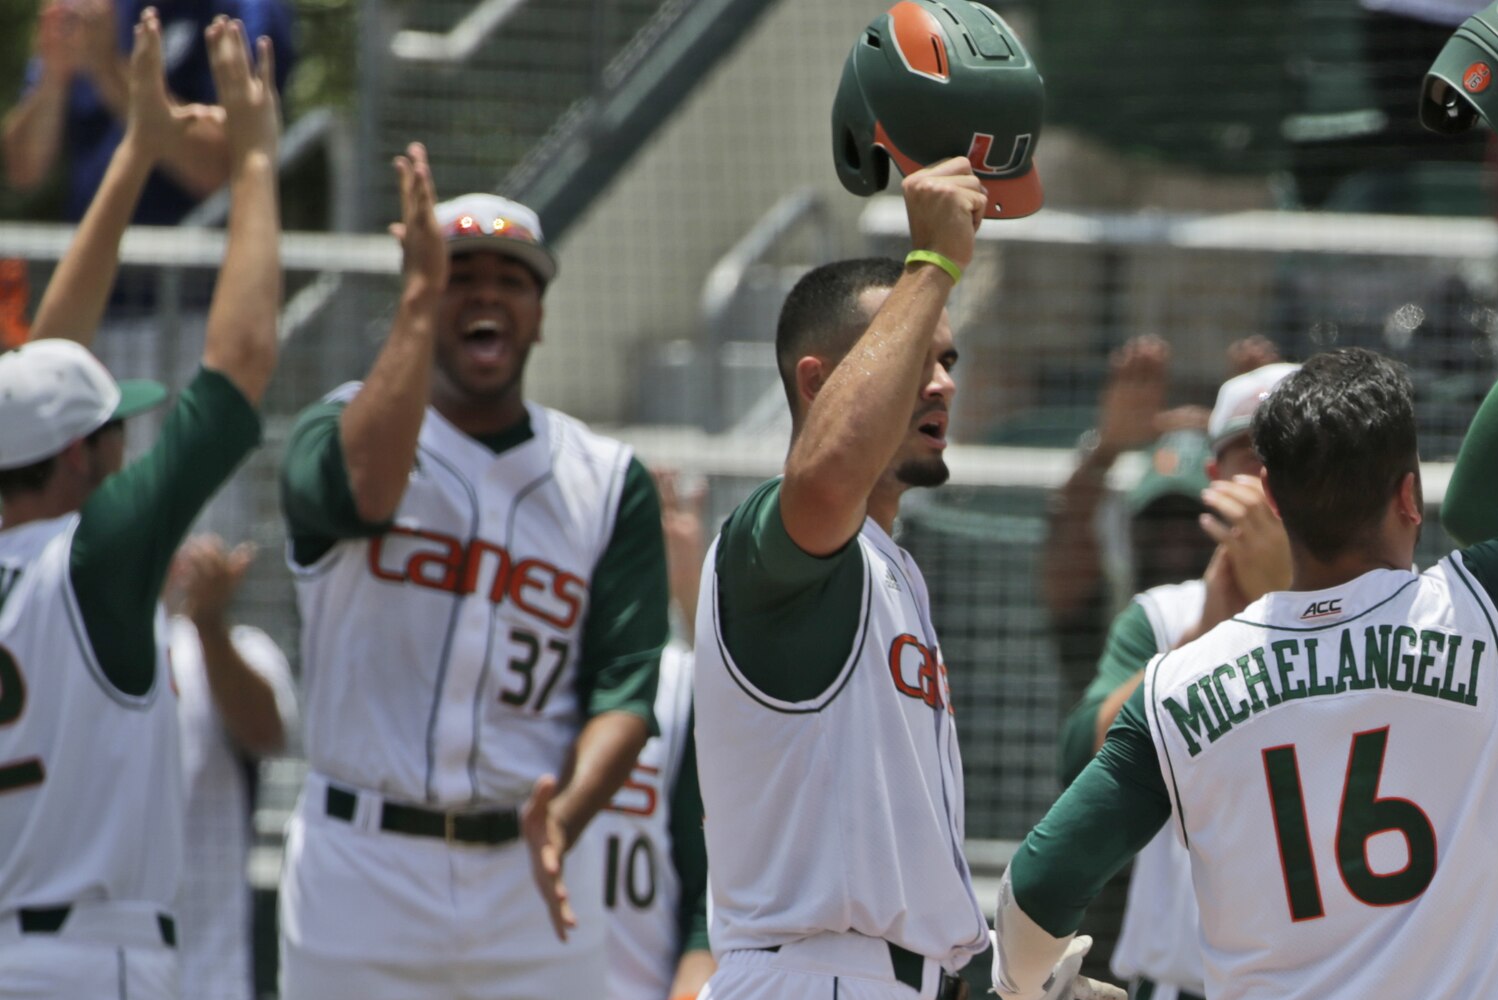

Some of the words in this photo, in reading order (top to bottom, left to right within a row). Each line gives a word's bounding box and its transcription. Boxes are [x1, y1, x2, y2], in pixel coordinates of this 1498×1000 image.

[966, 132, 1032, 175] U
[1302, 598, 1343, 616] ACC
[500, 628, 571, 712] 37
[1161, 624, 1486, 758] MICHELANGELI
[1261, 724, 1438, 923] 16
[604, 833, 656, 910] 10
